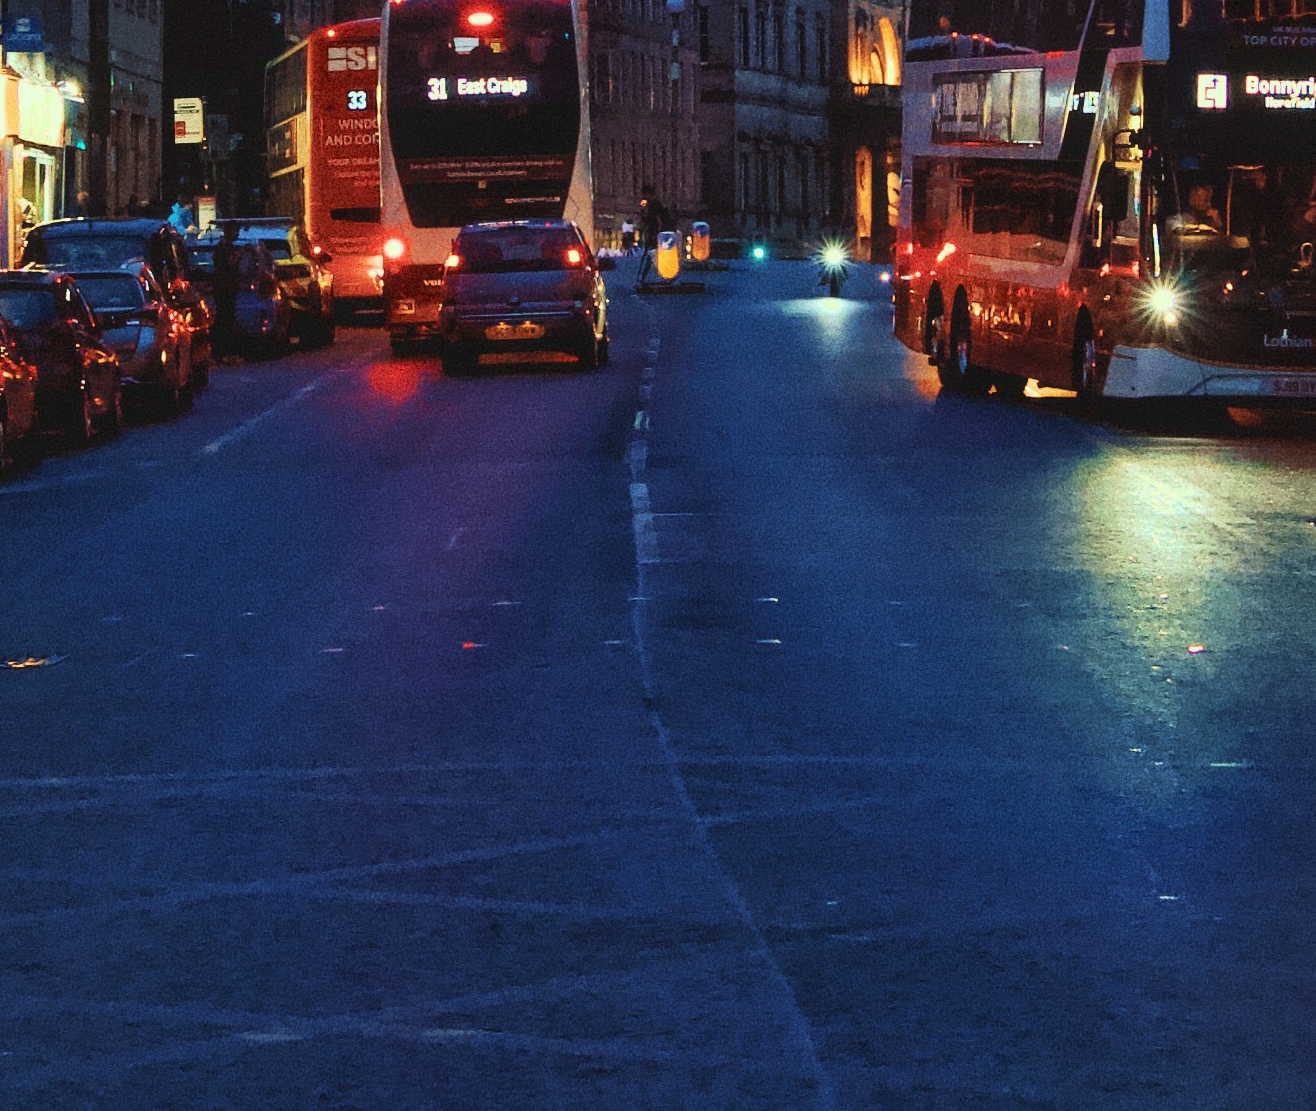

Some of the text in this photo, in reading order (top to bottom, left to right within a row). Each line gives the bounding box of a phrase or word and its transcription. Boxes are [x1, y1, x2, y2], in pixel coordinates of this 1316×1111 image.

[1243, 35, 1267, 46] TOP
[1270, 36, 1298, 46] CITY
[427, 76, 528, 101] 31 East Craigs
[347, 90, 367, 110] 33
[325, 134, 352, 146] AND
[1264, 333, 1313, 347] Lothian
